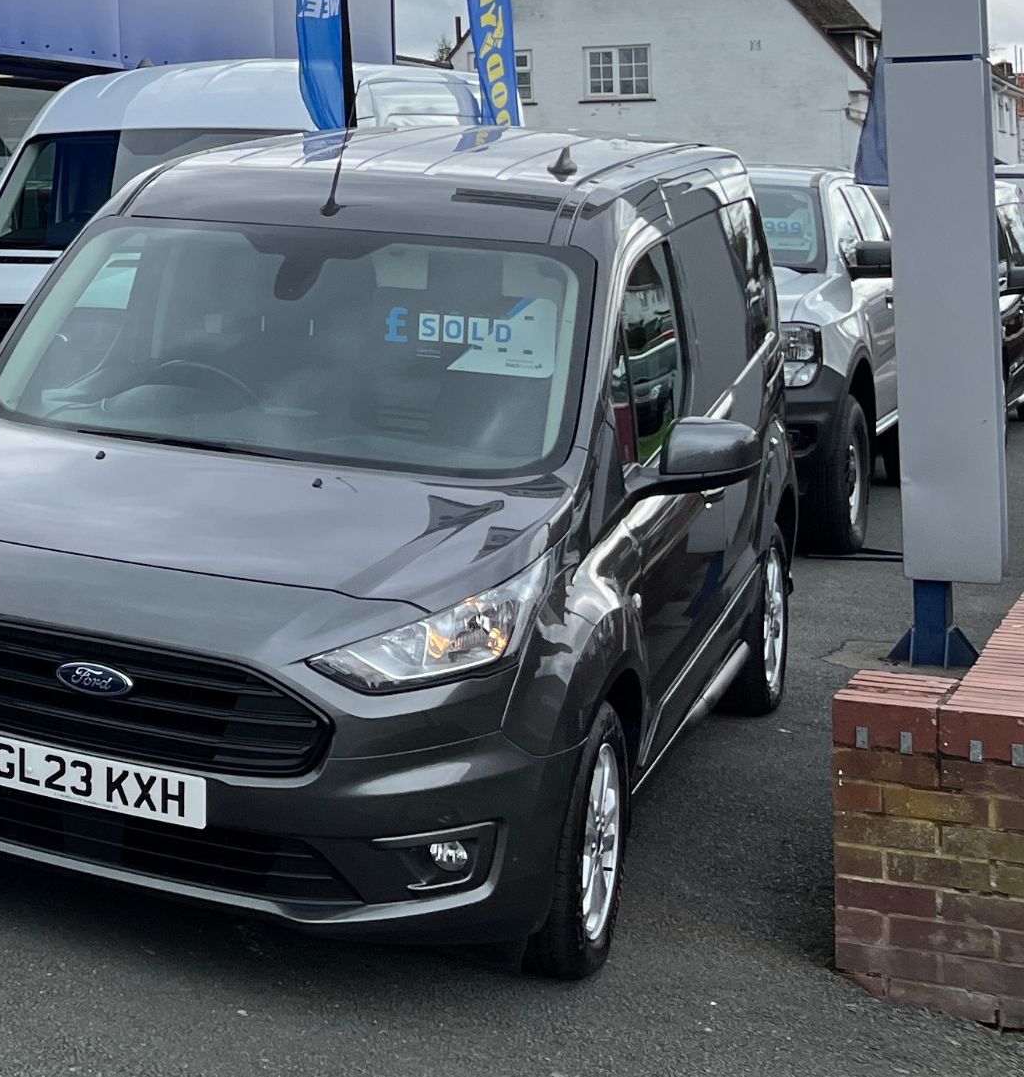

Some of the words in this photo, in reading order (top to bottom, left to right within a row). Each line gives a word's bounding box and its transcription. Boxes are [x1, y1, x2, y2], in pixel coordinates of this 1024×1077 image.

[421, 317, 512, 343] SOLD
[71, 666, 113, 691] Ford
[106, 766, 185, 818] KXH
